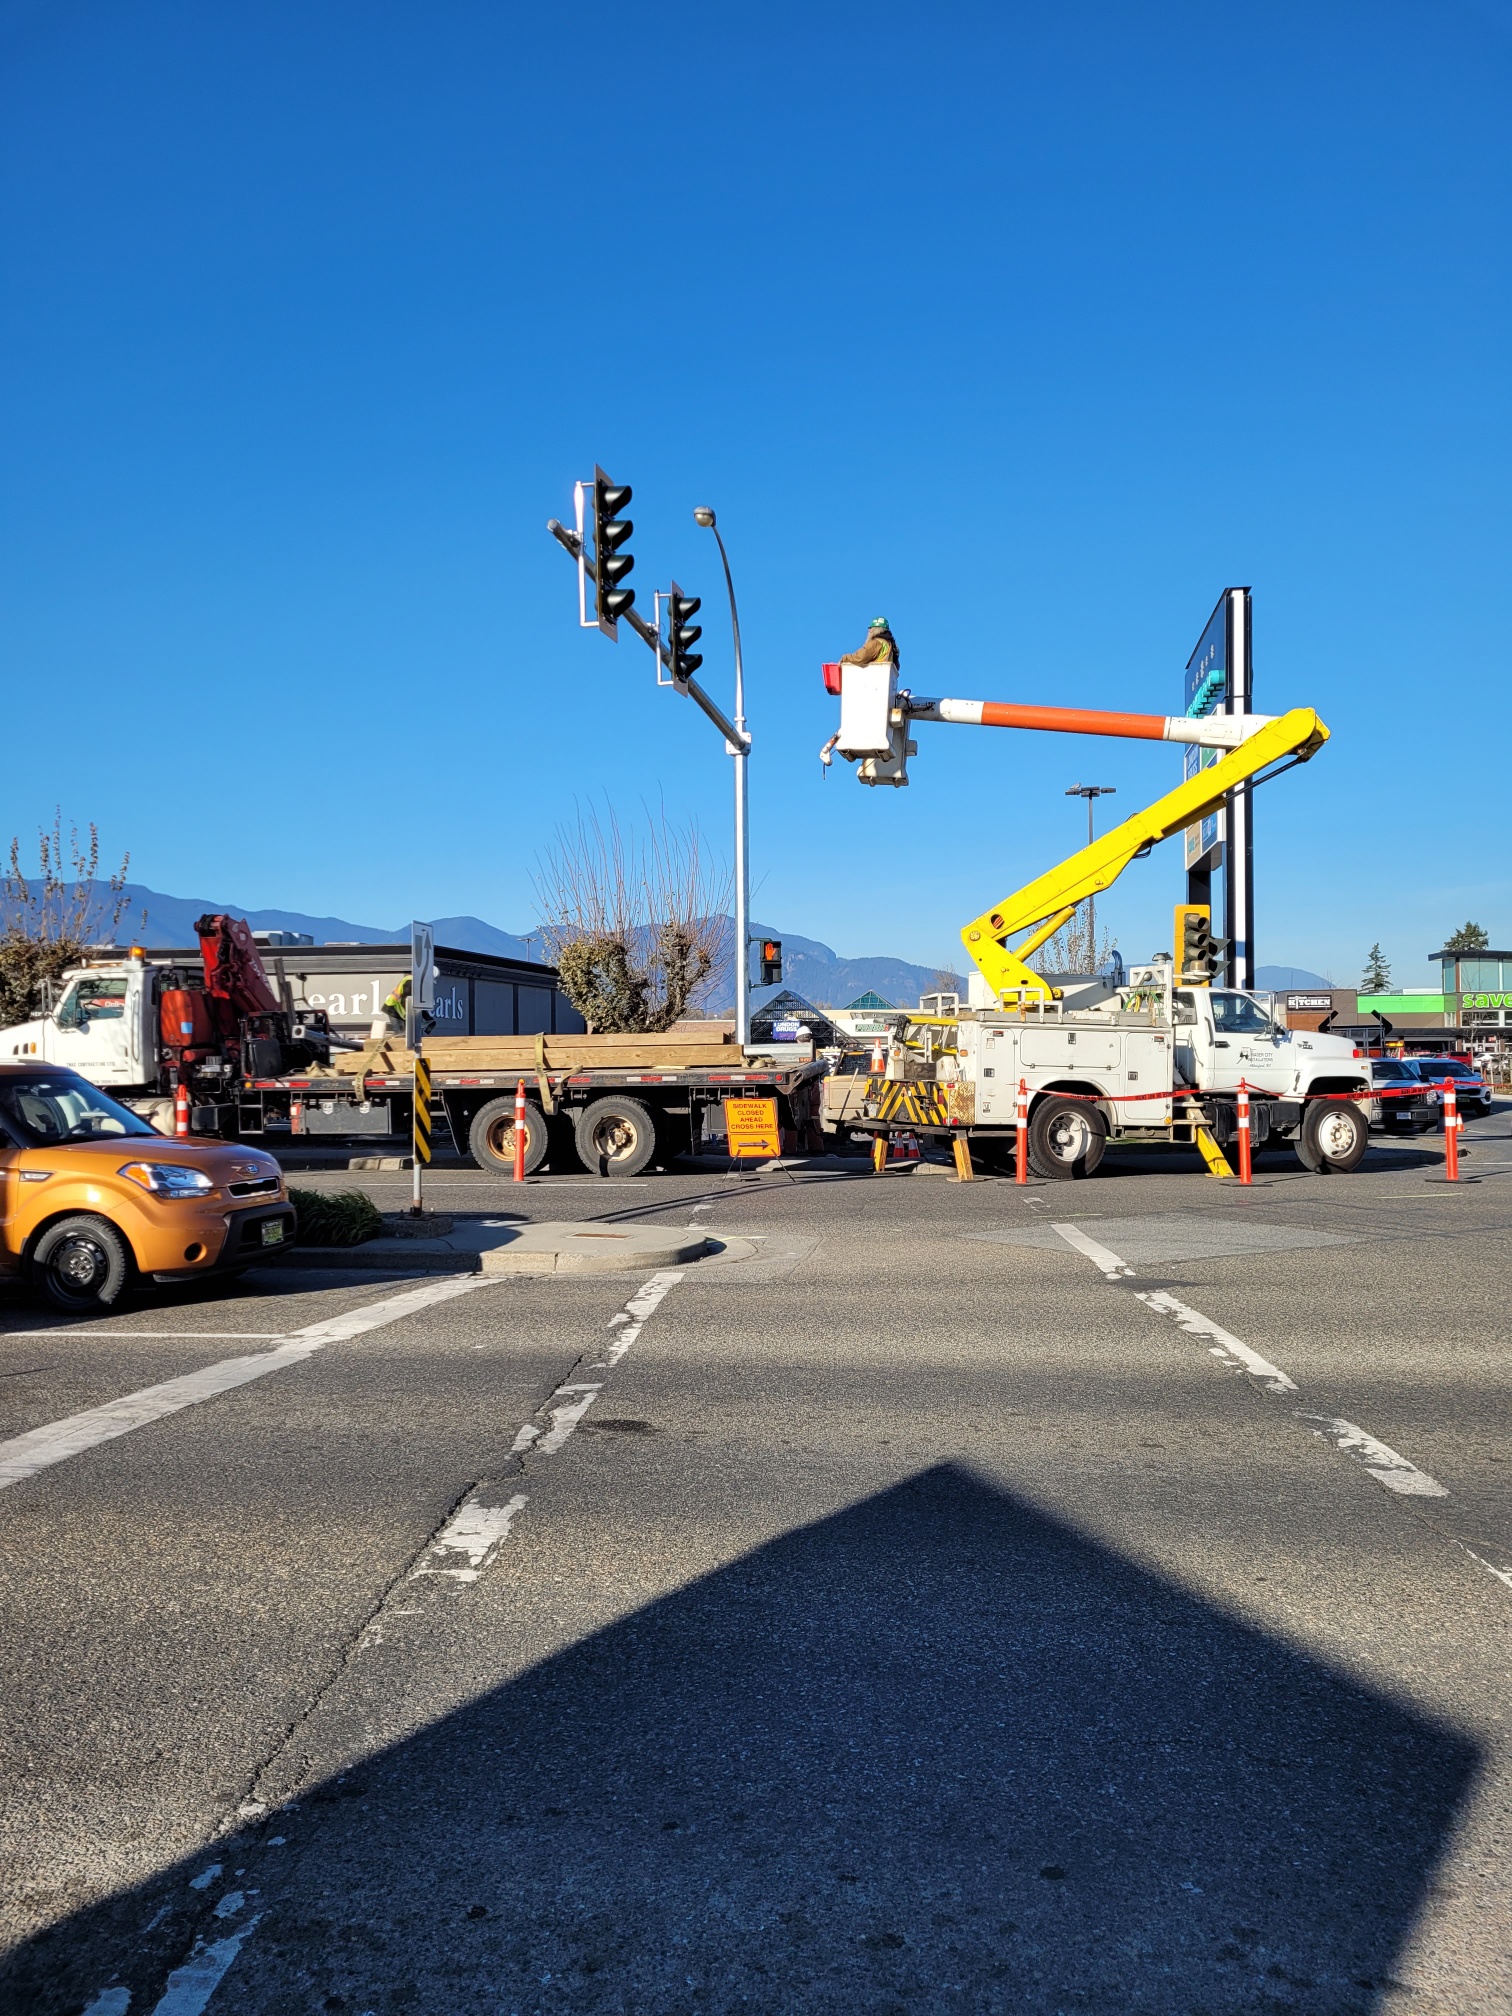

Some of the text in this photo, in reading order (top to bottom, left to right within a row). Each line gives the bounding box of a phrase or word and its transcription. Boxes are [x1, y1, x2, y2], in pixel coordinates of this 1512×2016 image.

[308, 980, 389, 1015] earl
[428, 986, 463, 1019] earls
[1288, 998, 1331, 1009] KITCHEN
[1463, 993, 1512, 1009] save
